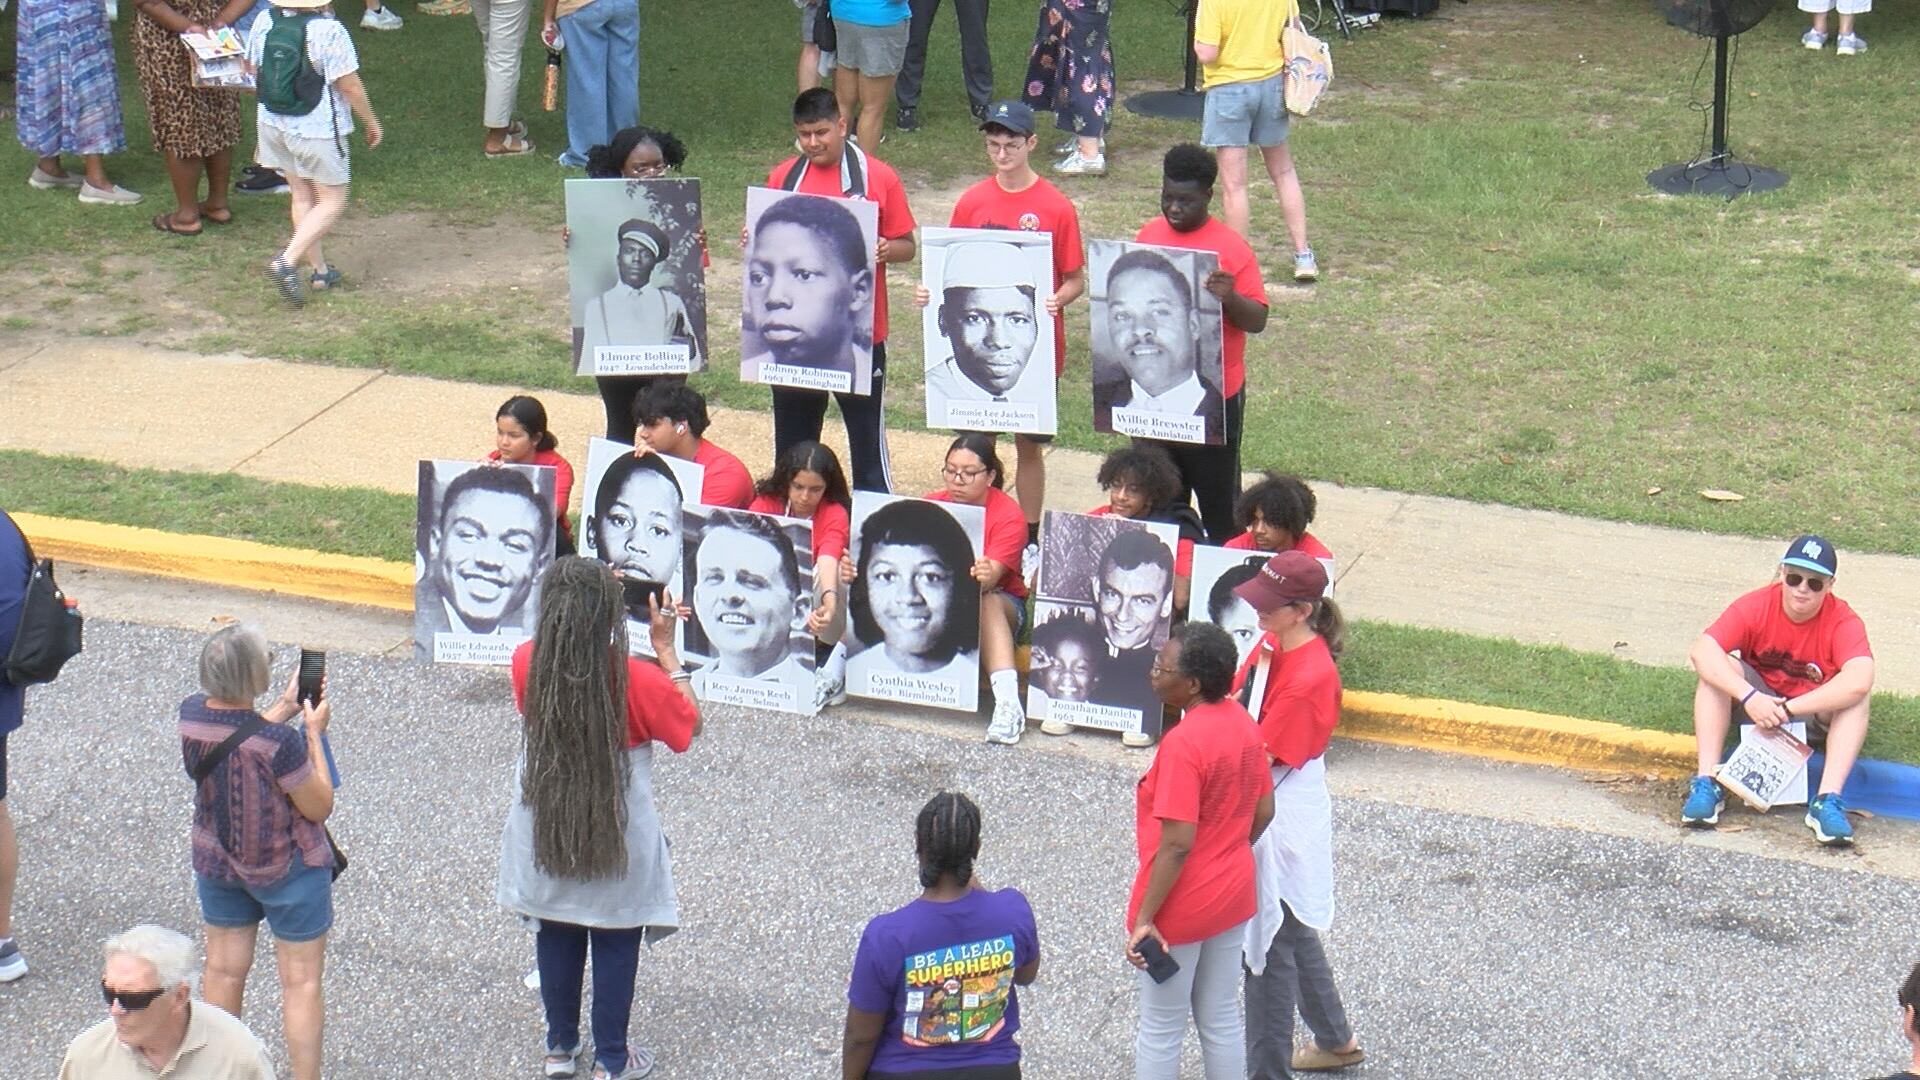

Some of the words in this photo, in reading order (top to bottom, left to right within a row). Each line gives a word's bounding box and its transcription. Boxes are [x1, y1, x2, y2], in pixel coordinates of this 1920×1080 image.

[601, 352, 641, 361] Elmore
[645, 351, 684, 362] Bolling
[764, 364, 799, 375] Johnny
[801, 368, 846, 379] Robinson
[791, 377, 846, 389] Birmingham
[950, 408, 982, 417] Jimmie
[984, 409, 999, 417] Lee
[1001, 410, 1035, 419] Jackson
[990, 419, 1020, 427] Marion
[1117, 413, 1149, 426] Willie
[1152, 417, 1201, 431] Brewster
[1124, 427, 1146, 436] 1965
[1151, 429, 1193, 440] Anniston
[439, 640, 466, 650] Willie
[469, 642, 512, 652] Edwards,
[468, 652, 512, 661] Montgom
[712, 682, 733, 692] Rev.
[734, 685, 765, 696] James
[871, 674, 914, 688] Cynthia
[916, 679, 956, 694] Wesley
[871, 687, 892, 696] 1963
[898, 689, 956, 703] Birmingham
[753, 697, 780, 708] Selma
[1052, 700, 1098, 714] Jonathan
[1100, 707, 1137, 719] Daniels
[1054, 712, 1074, 722] 1965
[1085, 716, 1135, 730] Hayneville
[914, 952, 937, 969] BE
[943, 948, 955, 963] A
[961, 939, 1006, 960] LEAD
[906, 950, 1014, 985] SUPERHERO
